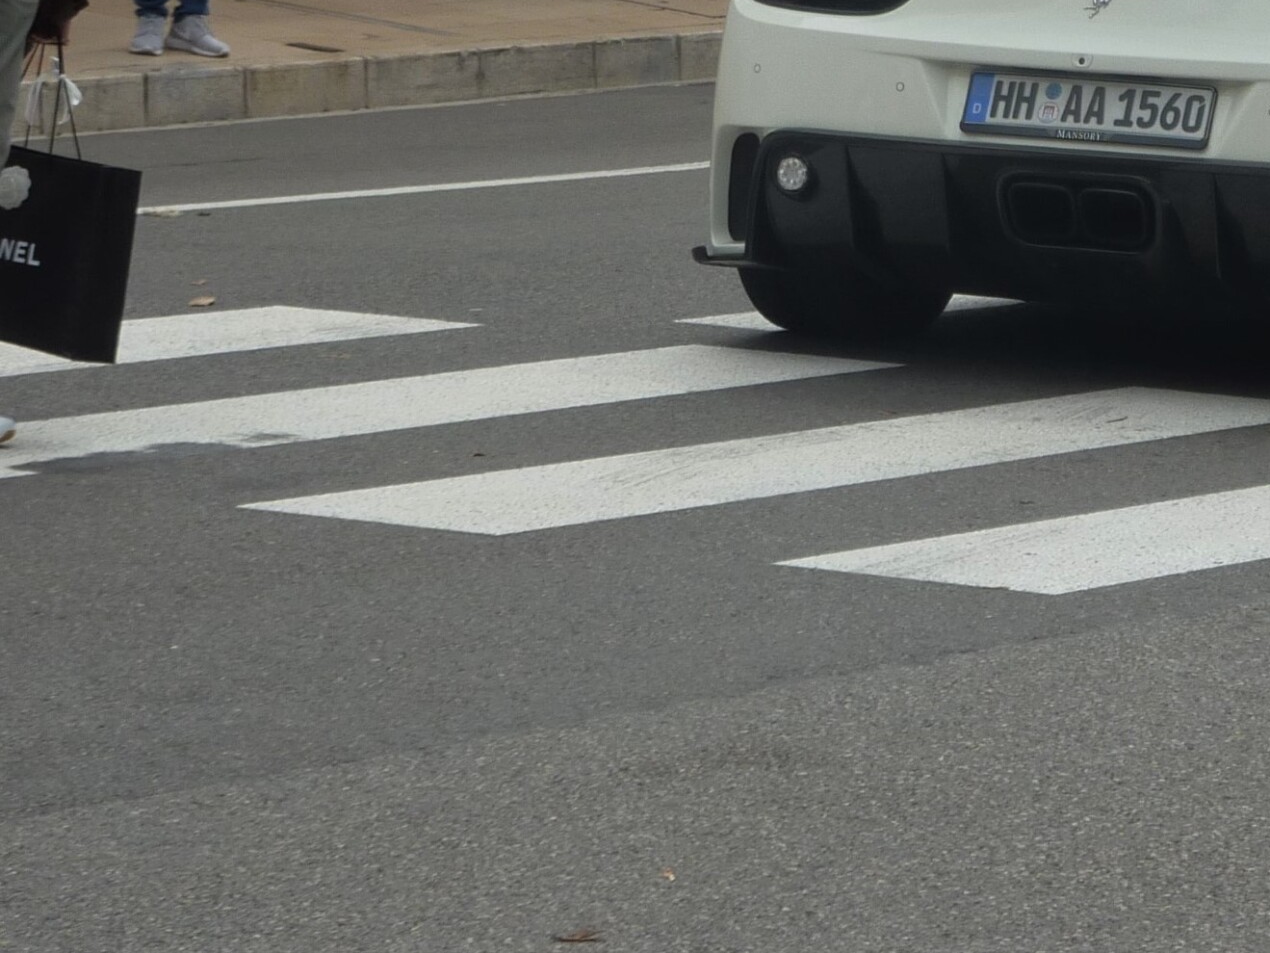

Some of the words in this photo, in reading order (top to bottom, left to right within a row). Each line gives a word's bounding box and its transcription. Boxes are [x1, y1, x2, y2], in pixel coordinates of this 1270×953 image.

[990, 80, 1039, 120] HH
[1060, 85, 1106, 125] AA
[1113, 88, 1206, 133] 1560
